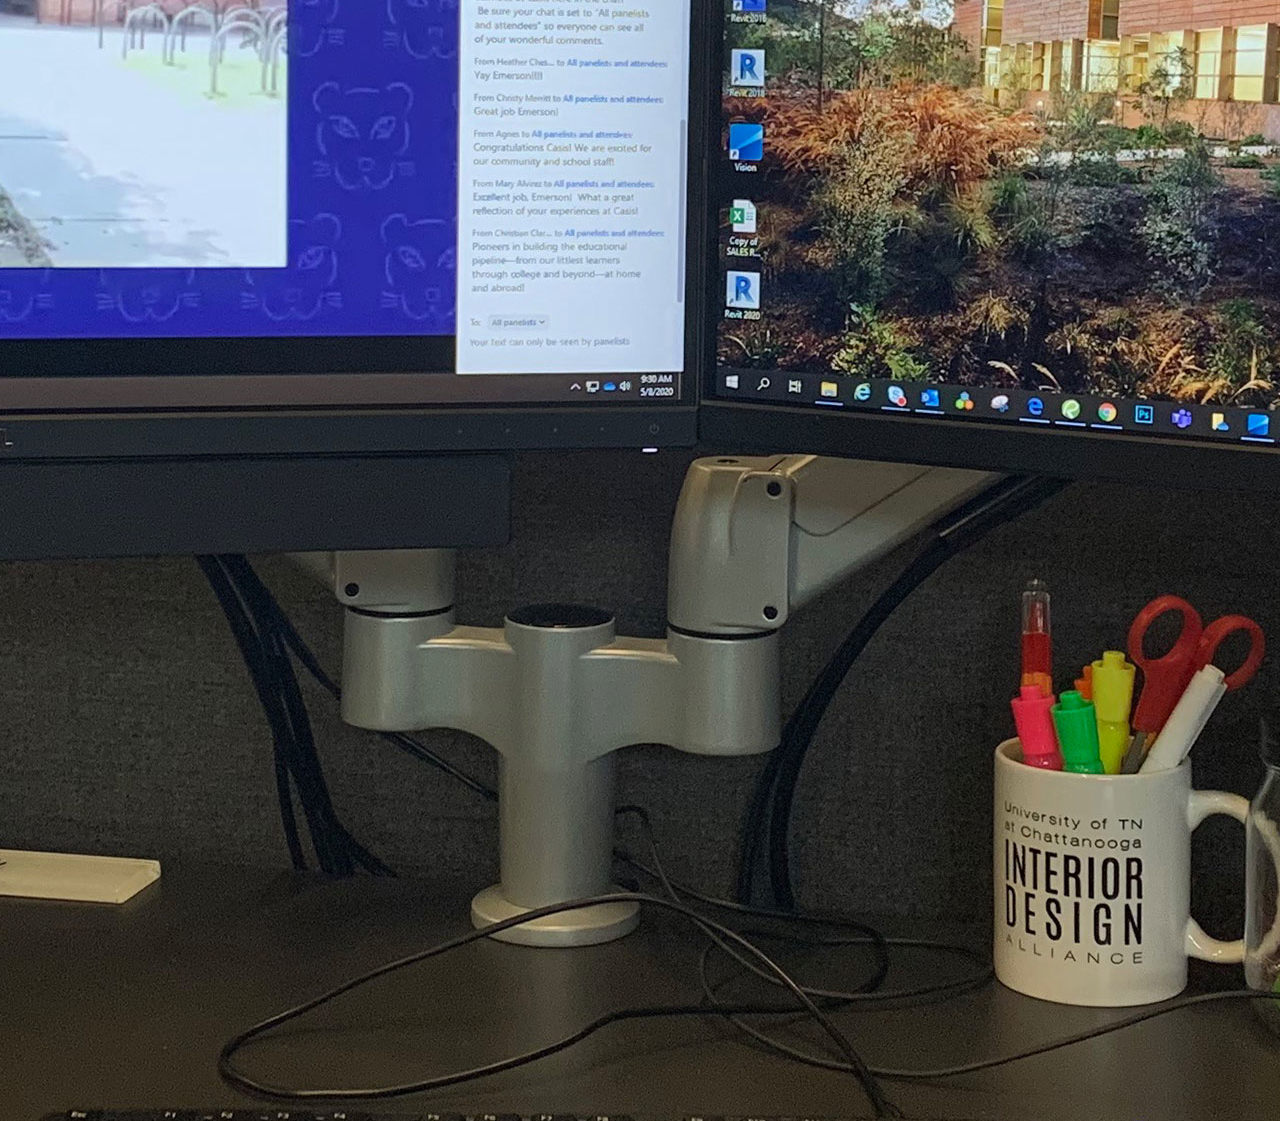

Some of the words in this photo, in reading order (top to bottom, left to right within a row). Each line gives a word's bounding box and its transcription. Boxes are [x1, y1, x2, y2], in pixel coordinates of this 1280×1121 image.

[474, 71, 490, 81] Yay
[474, 107, 498, 115] Great
[501, 107, 515, 117] job
[474, 143, 544, 153] Congratulations
[608, 144, 637, 152] excited
[640, 144, 651, 152] for
[734, 163, 757, 172] Vision
[729, 236, 748, 247] Copy
[750, 238, 758, 246] of
[472, 242, 510, 250] Pioneers
[523, 242, 558, 252] building
[561, 242, 575, 250] the
[578, 242, 627, 250] educational
[727, 247, 749, 256] SALES
[724, 309, 742, 319] Revit
[504, 318, 536, 327] panelists
[658, 375, 672, 383] AM
[1004, 800, 1081, 829] University
[1090, 818, 1107, 830] of
[1118, 818, 1144, 830] TN
[1004, 820, 1016, 832] at
[1020, 826, 1142, 851] Chattanooga
[1005, 838, 1144, 900] INTERIOR
[1006, 883, 1142, 946] DESIGN
[1005, 933, 1144, 965] ALLIANCE
